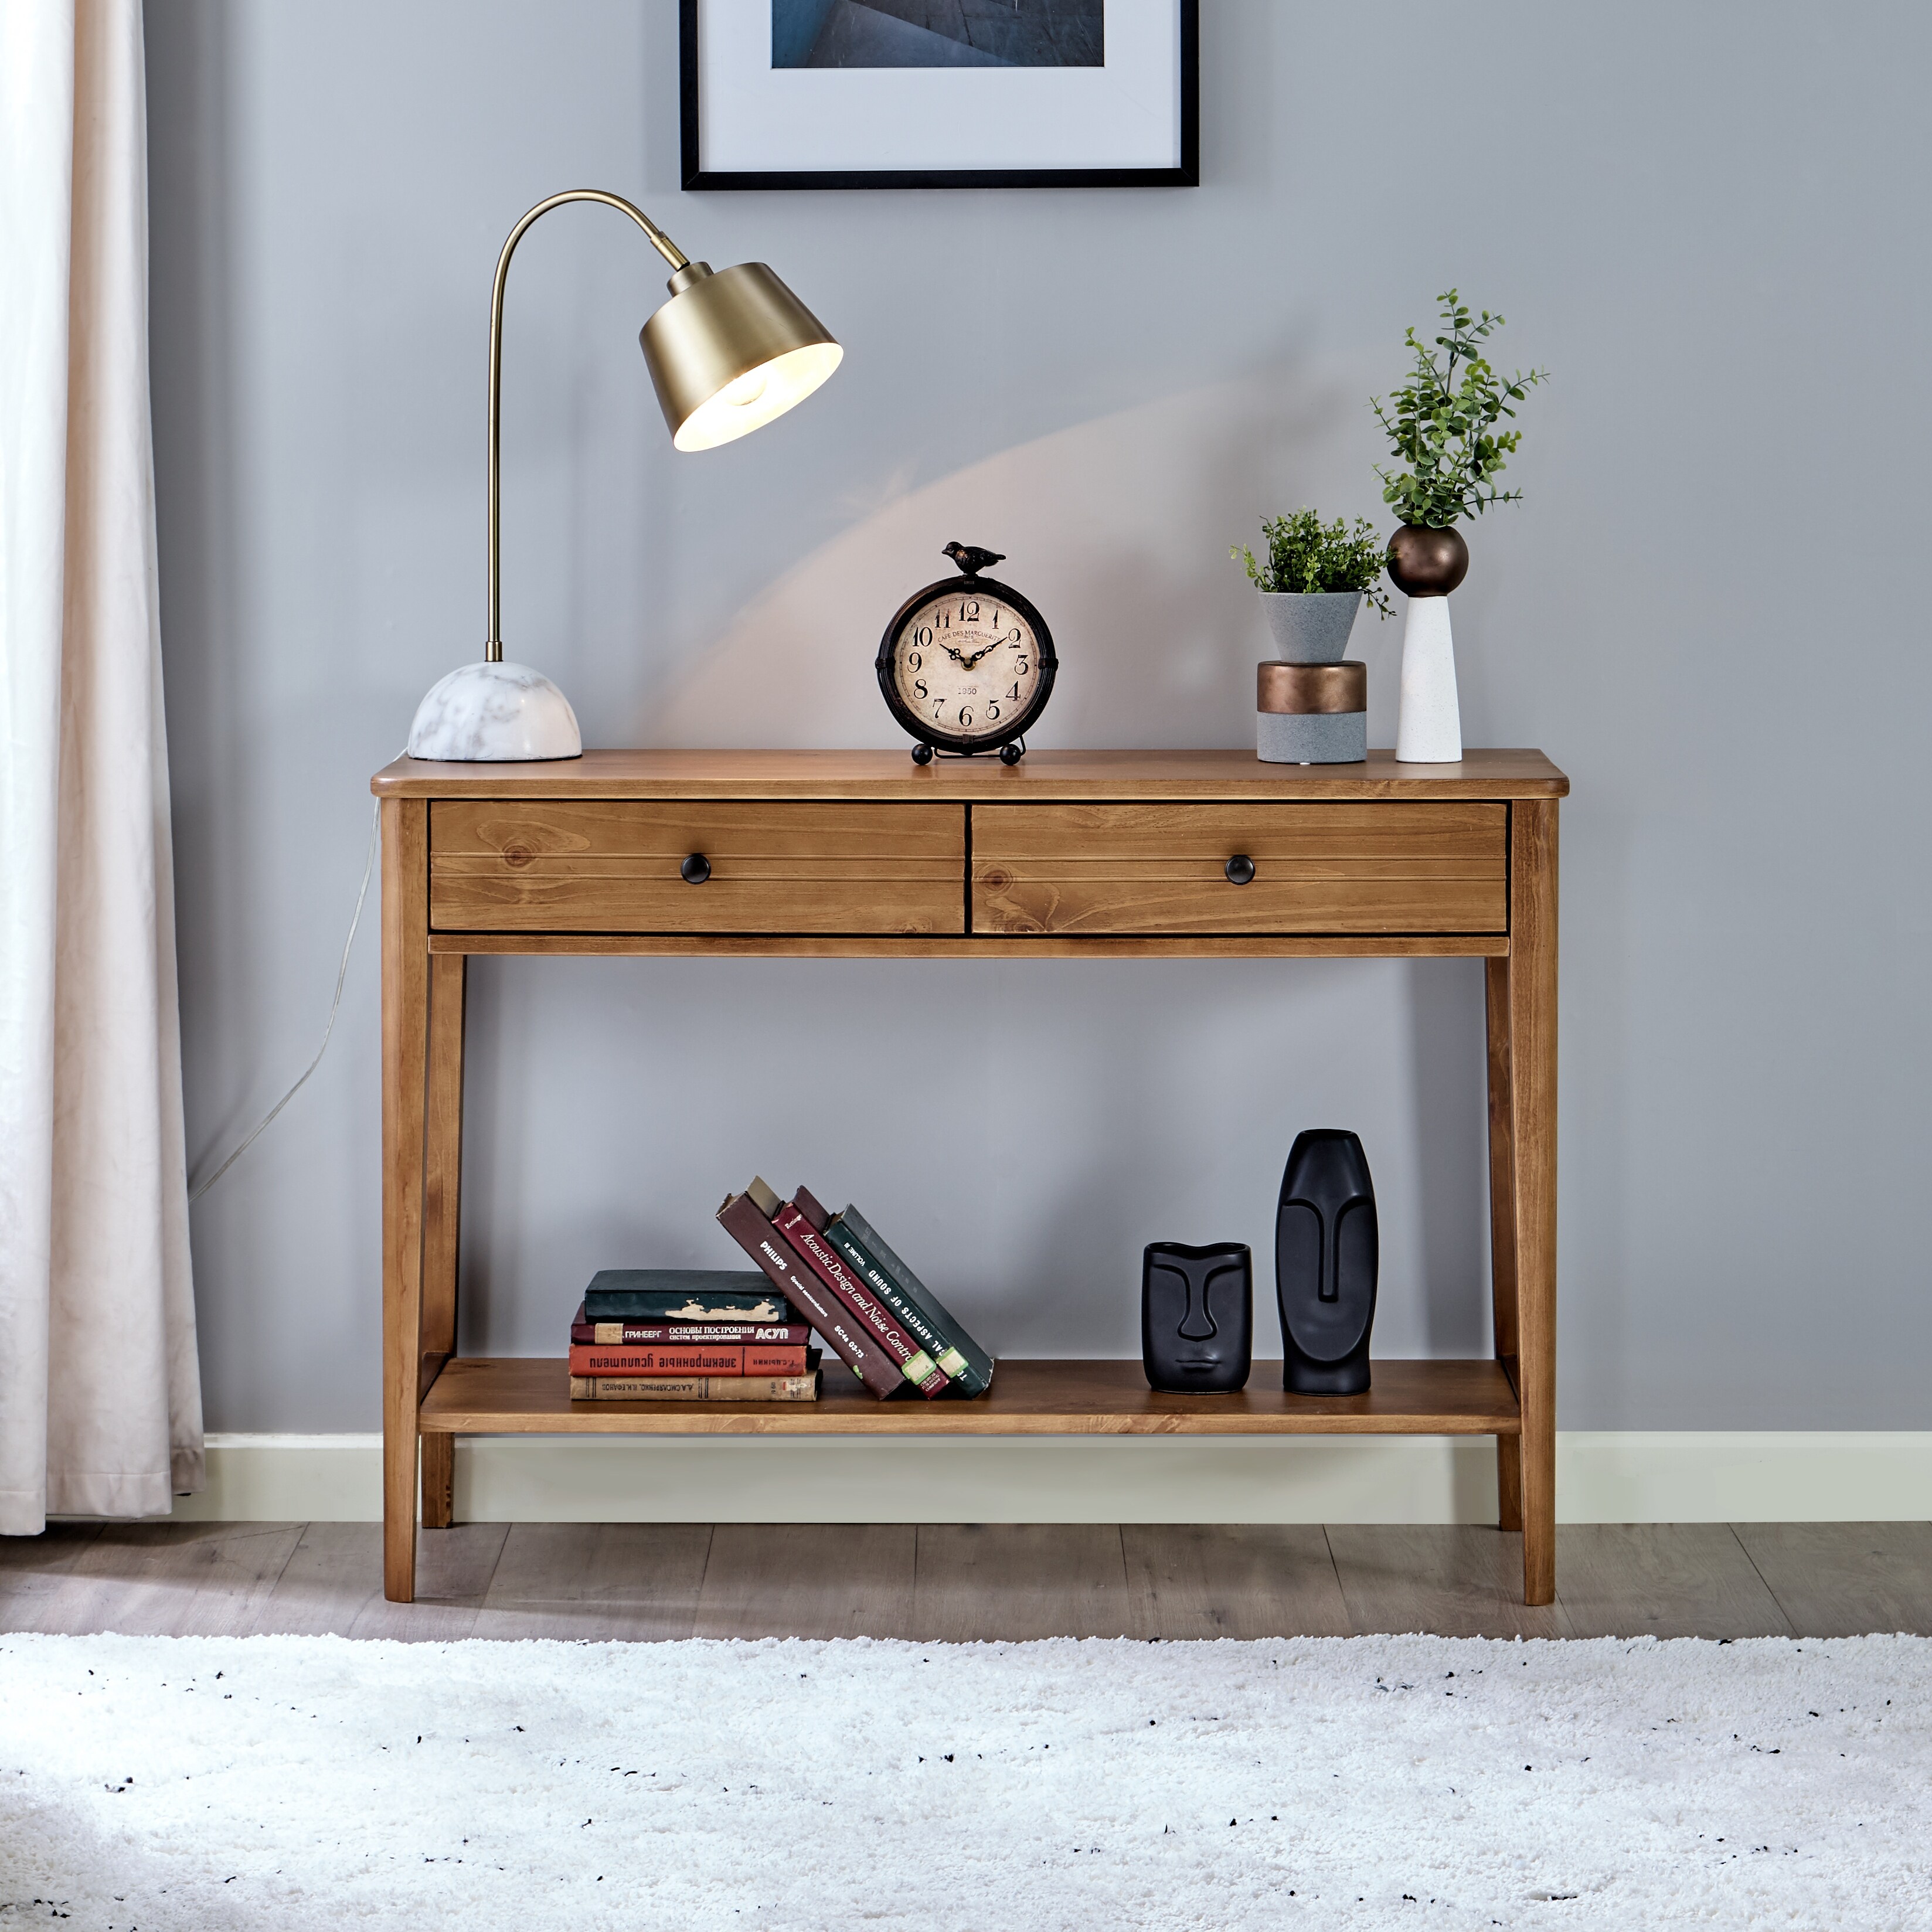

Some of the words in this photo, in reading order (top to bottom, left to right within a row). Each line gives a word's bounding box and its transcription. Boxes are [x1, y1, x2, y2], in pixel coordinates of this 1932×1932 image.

[934, 609, 951, 628] 11
[958, 601, 979, 621] 12
[992, 610, 999, 629] 1
[913, 627, 933, 647] 10
[1008, 628, 1021, 648] 2
[907, 652, 922, 673] 9
[1014, 655, 1029, 675] 3
[913, 679, 928, 699] 8
[1005, 681, 1021, 702] 4
[932, 699, 947, 719] 7
[959, 706, 974, 726] 6
[986, 699, 1000, 720] 5
[760, 1241, 788, 1270] PHILIPS
[848, 1247, 866, 1267] VOLUME
[868, 1270, 892, 1295] SOUND
[791, 1275, 804, 1291] Special
[802, 1290, 828, 1317] semiconductors
[800, 1234, 833, 1266] Acoustic
[827, 1263, 855, 1294] Design
[852, 1292, 873, 1311] and
[865, 1306, 889, 1333] Noise
[886, 1331, 913, 1362] Contro
[890, 1296, 902, 1307] OF
[755, 1328, 788, 1339] АСУП
[835, 1325, 849, 1342] SC4a
[901, 1307, 933, 1340] ASPECTS
[590, 1353, 654, 1368] усилители
[659, 1354, 736, 1368] электронные
